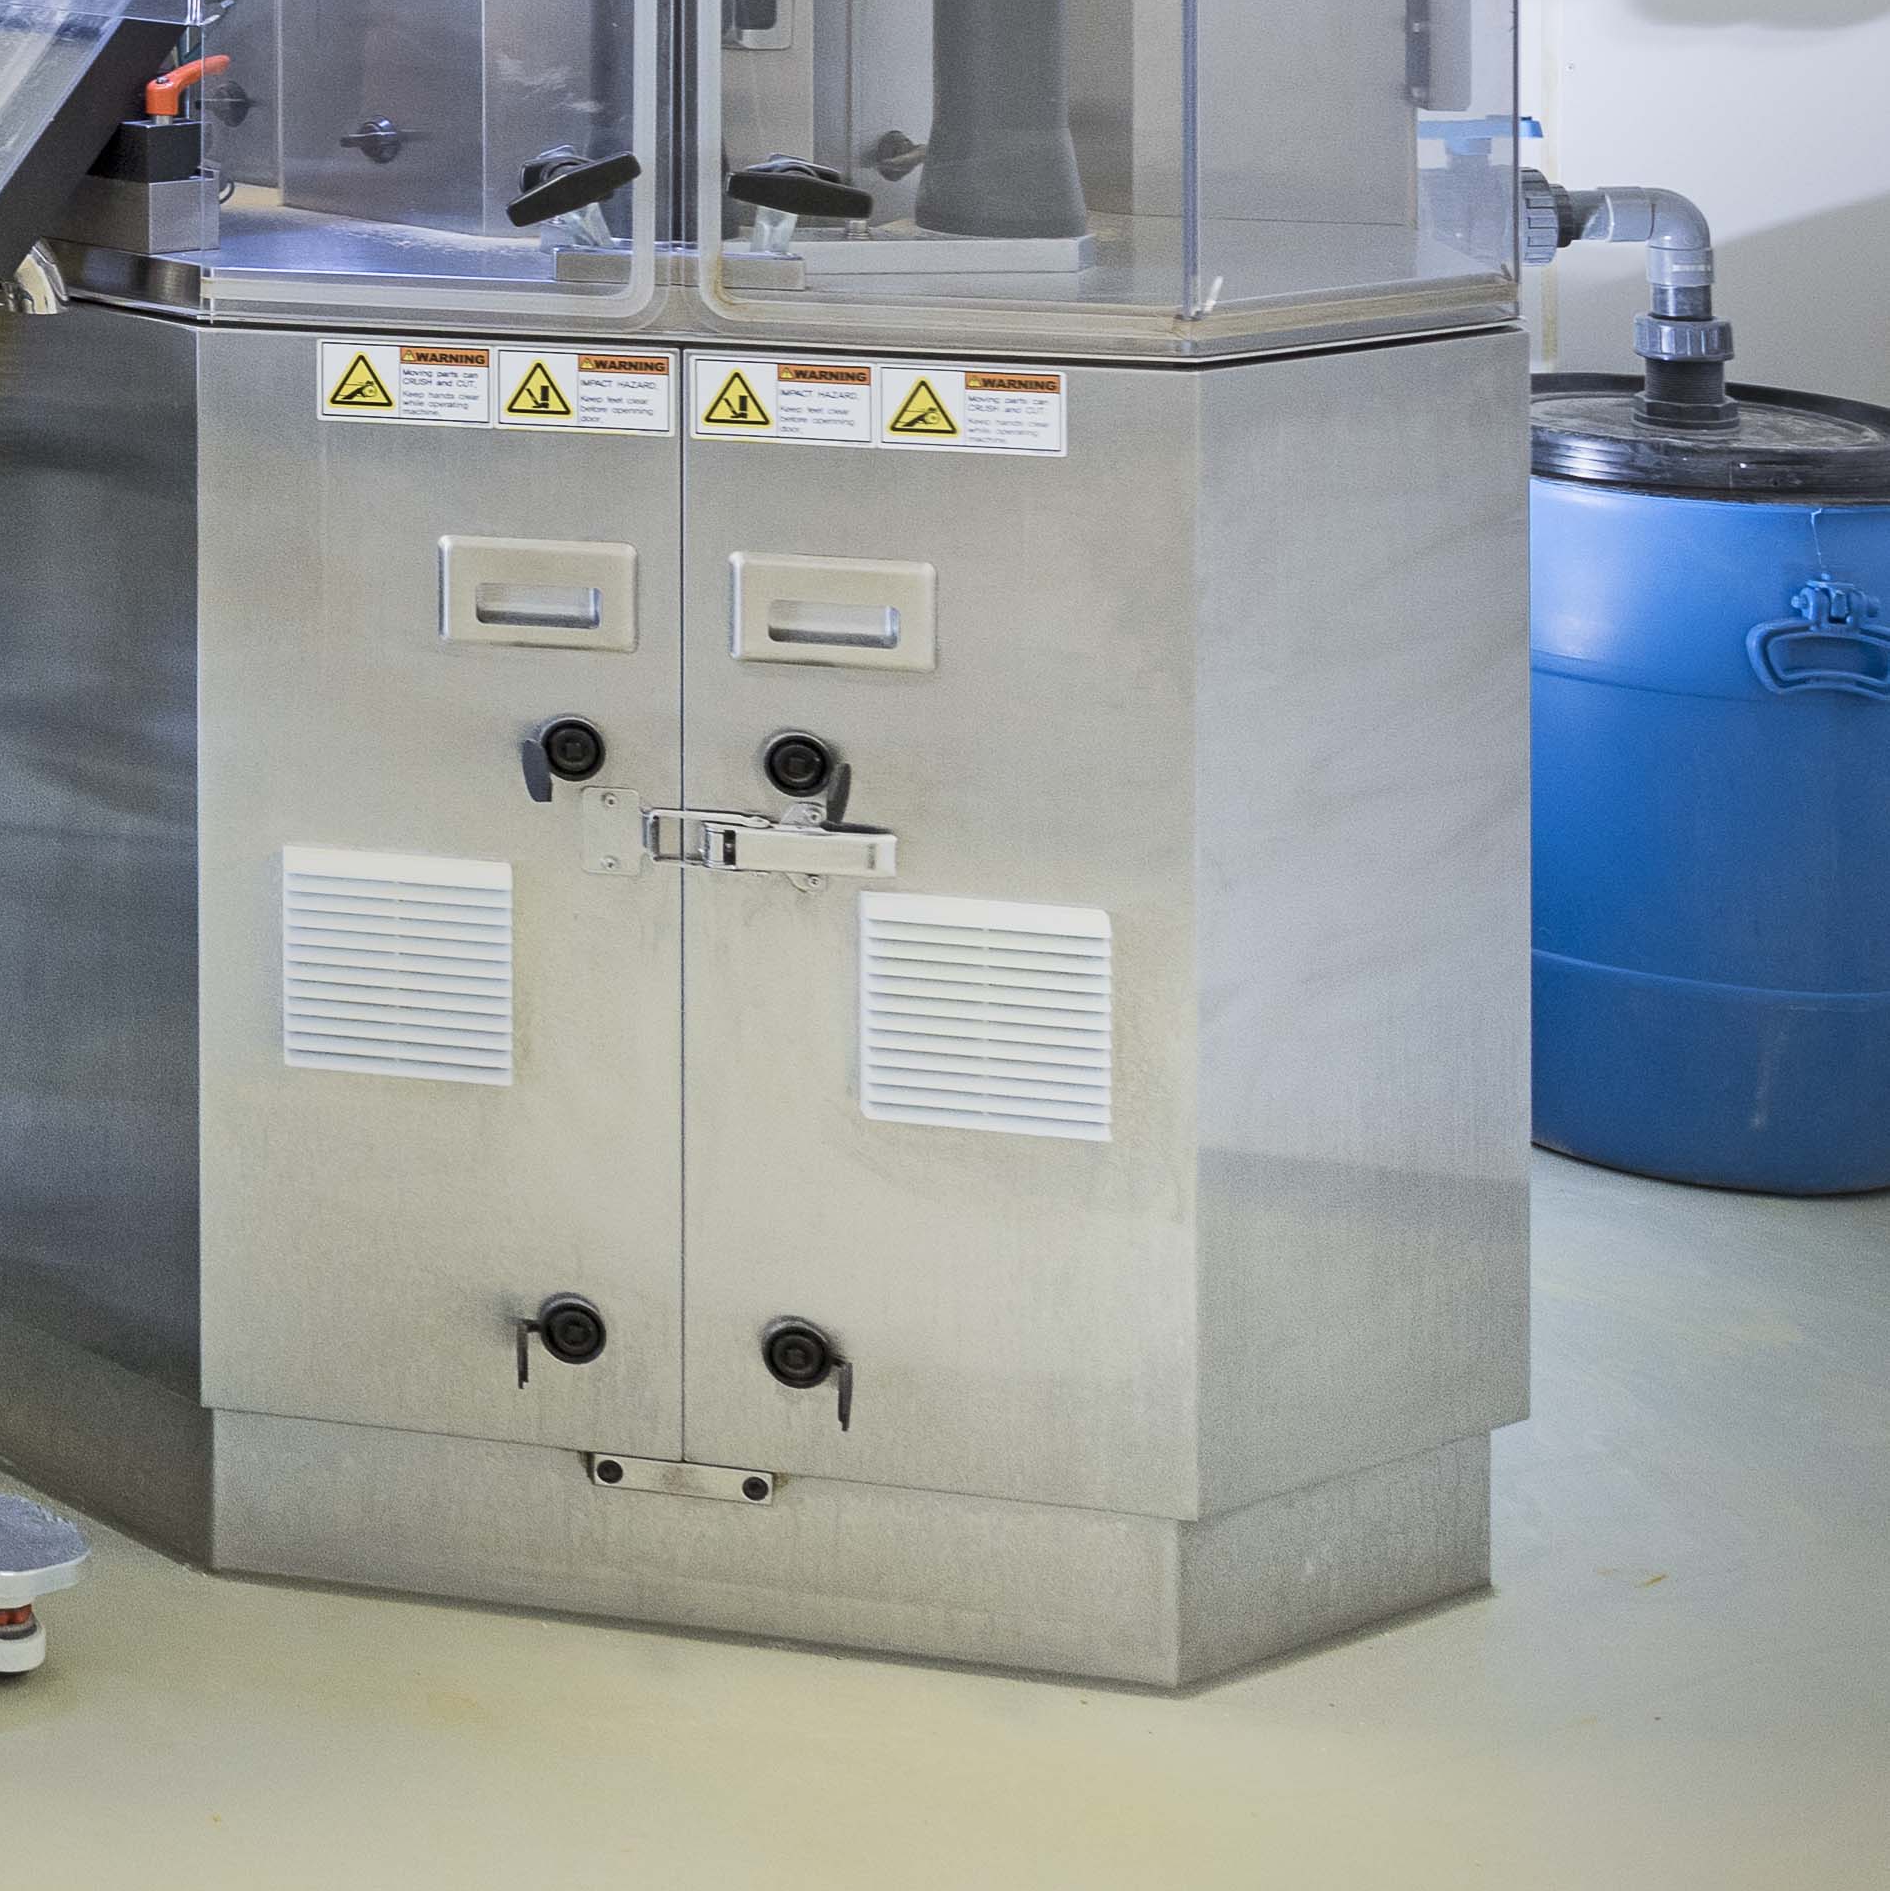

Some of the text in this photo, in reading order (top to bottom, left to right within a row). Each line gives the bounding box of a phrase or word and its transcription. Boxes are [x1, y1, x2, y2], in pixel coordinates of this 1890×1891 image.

[415, 352, 485, 364] WARNING
[594, 360, 666, 372] WARNING
[794, 370, 867, 382] WARNING
[981, 378, 1057, 390] WARNING
